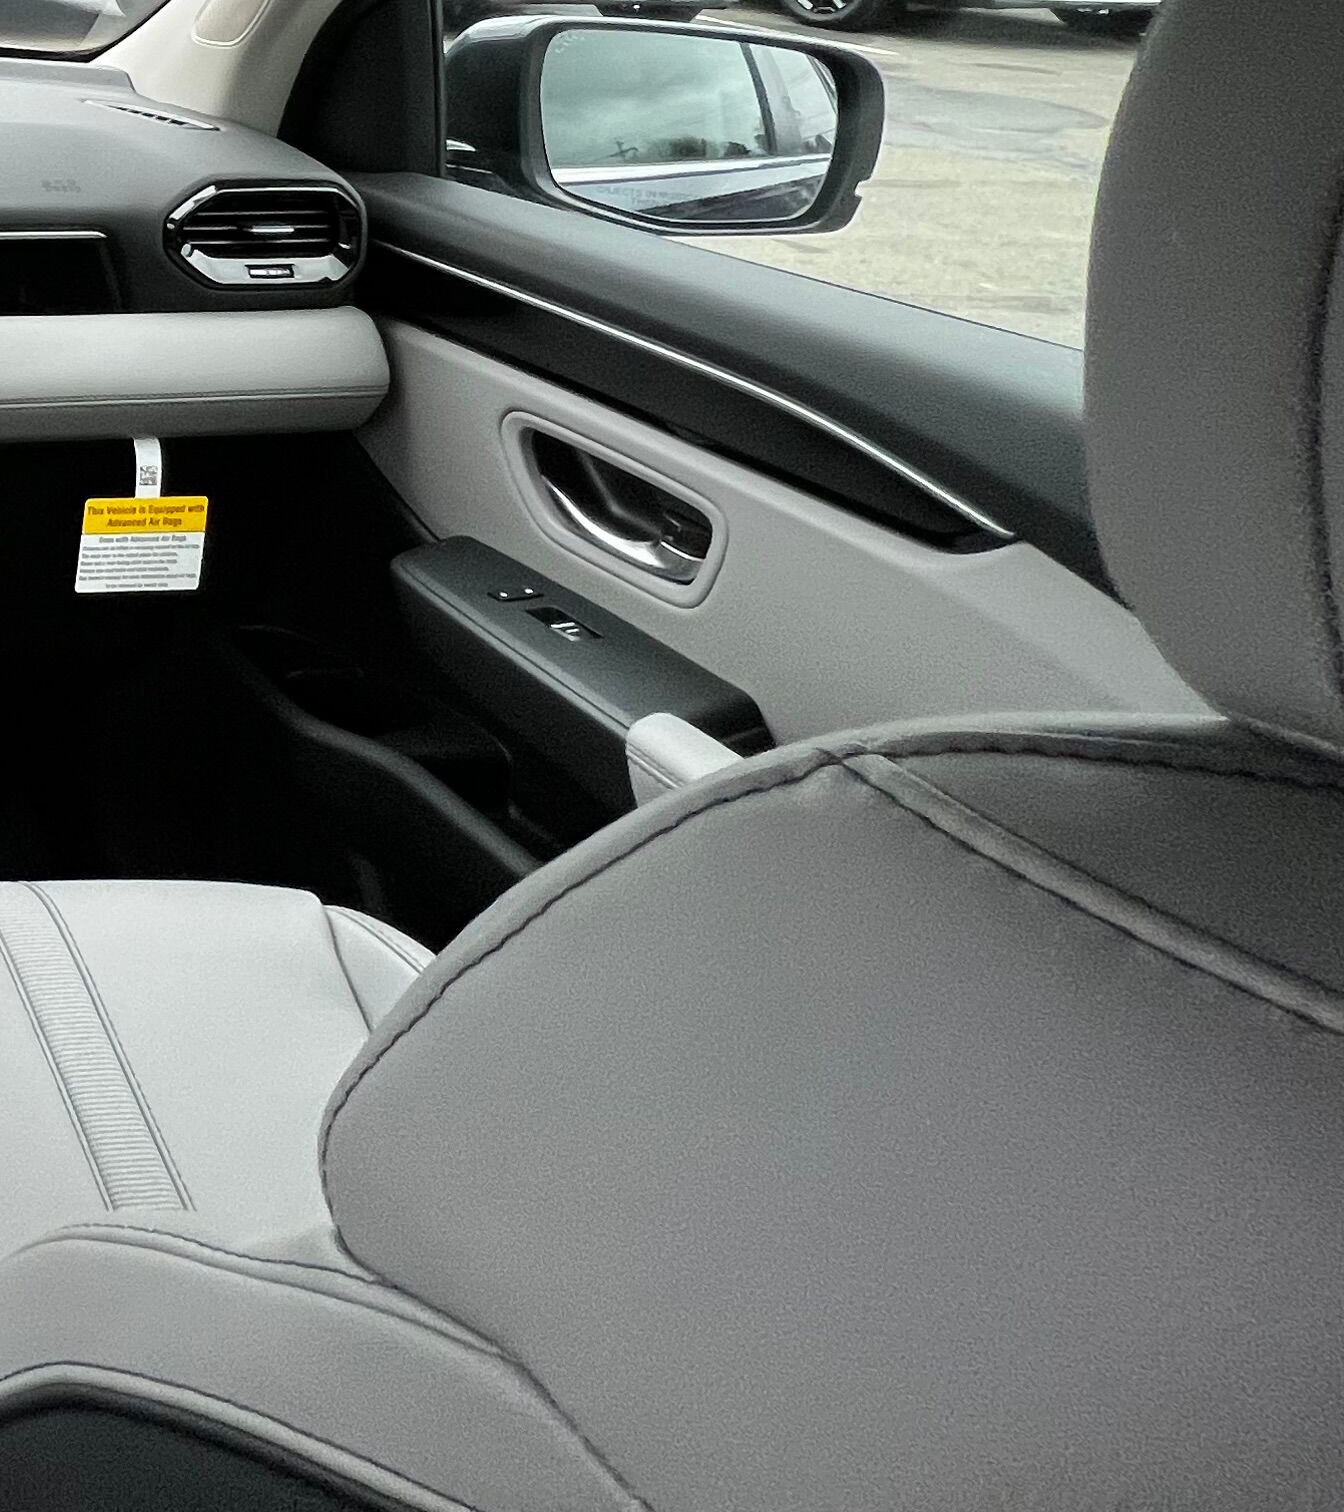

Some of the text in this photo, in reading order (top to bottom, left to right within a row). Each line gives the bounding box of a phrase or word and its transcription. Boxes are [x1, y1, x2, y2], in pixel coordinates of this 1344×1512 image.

[107, 505, 136, 514] Vehicle
[148, 504, 186, 514] Equipped
[187, 504, 205, 512] with
[107, 517, 182, 527] Advanced Air Bags
